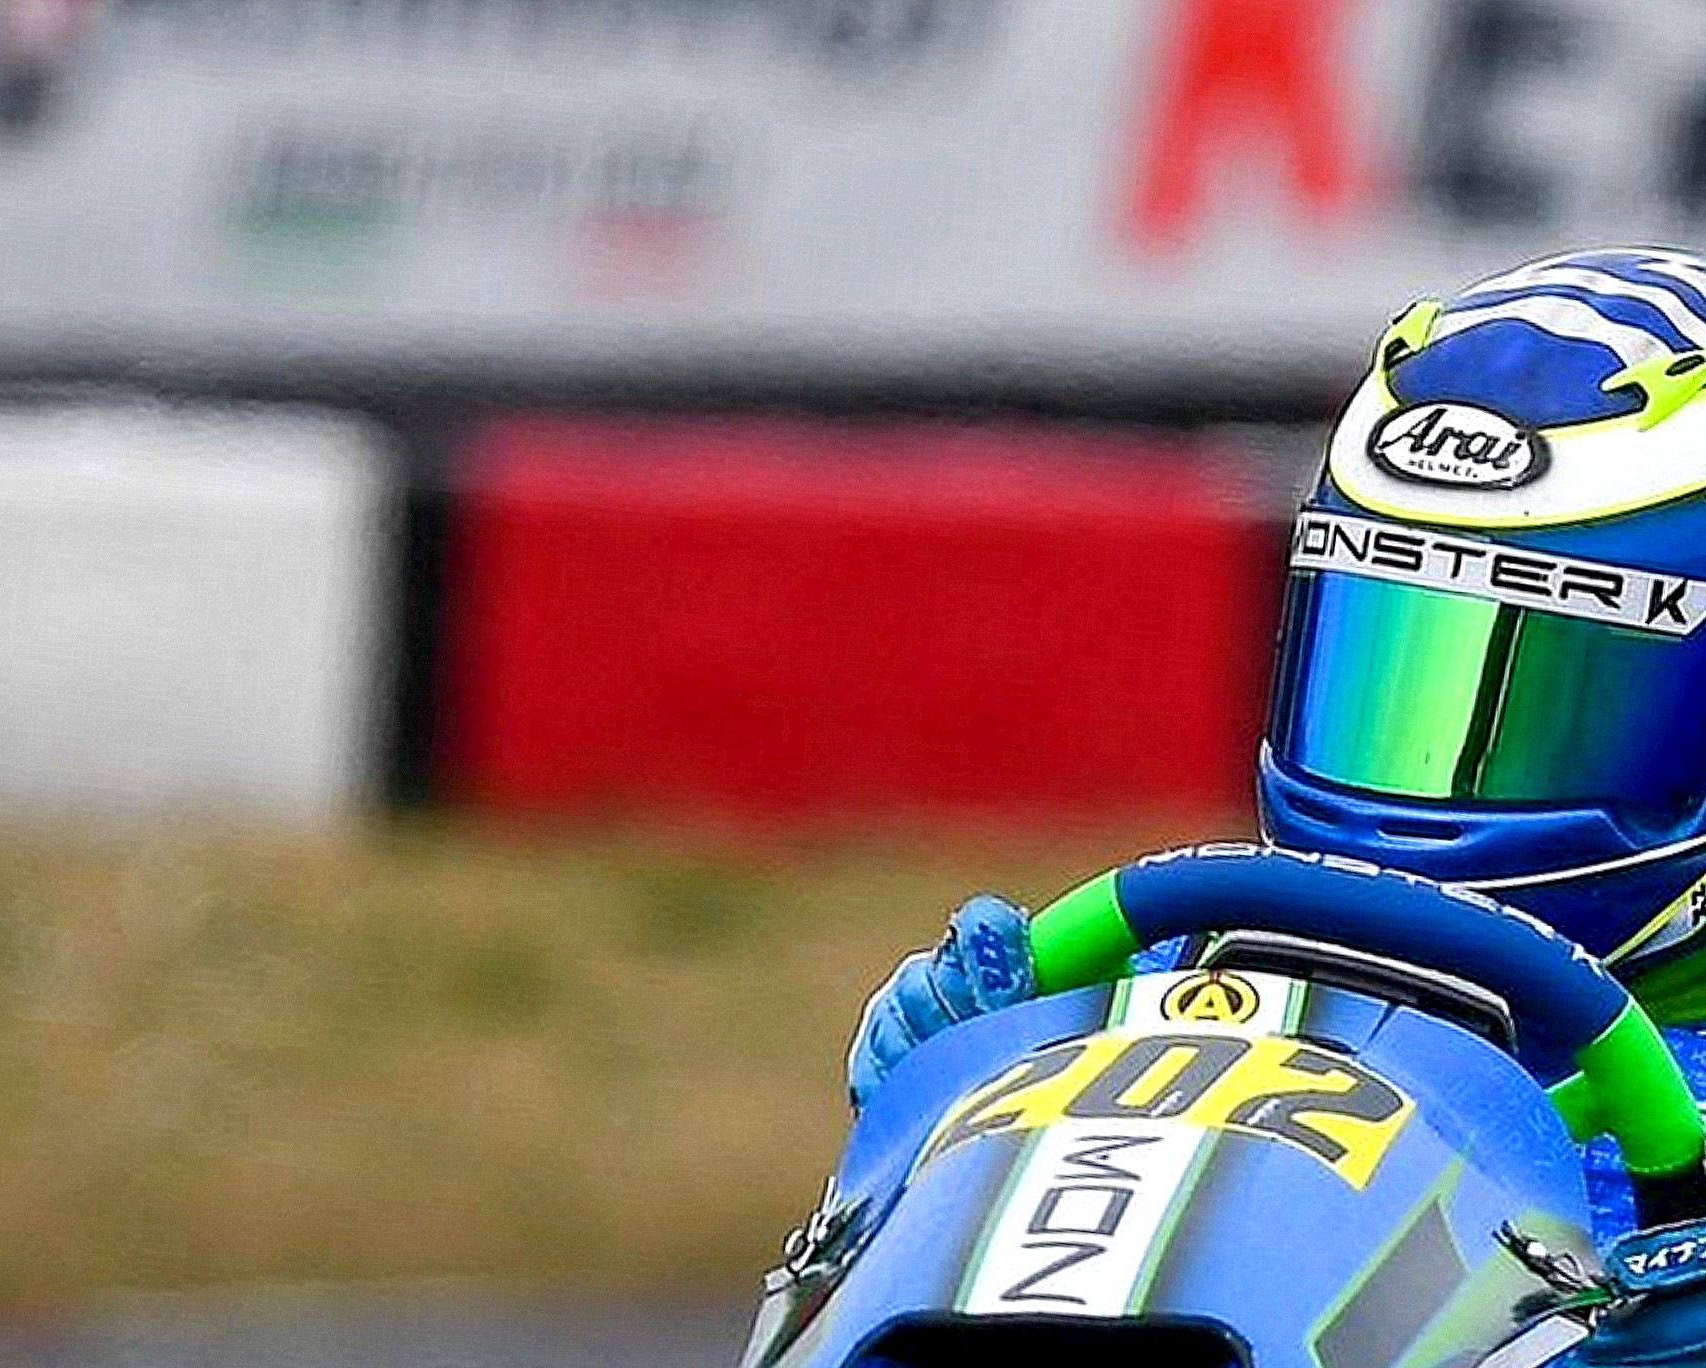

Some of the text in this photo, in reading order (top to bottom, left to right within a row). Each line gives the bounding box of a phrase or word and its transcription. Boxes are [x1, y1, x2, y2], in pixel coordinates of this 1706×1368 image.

[1378, 408, 1526, 470] Arai
[1645, 577, 1689, 626] K
[929, 1035, 1403, 1160] 202
